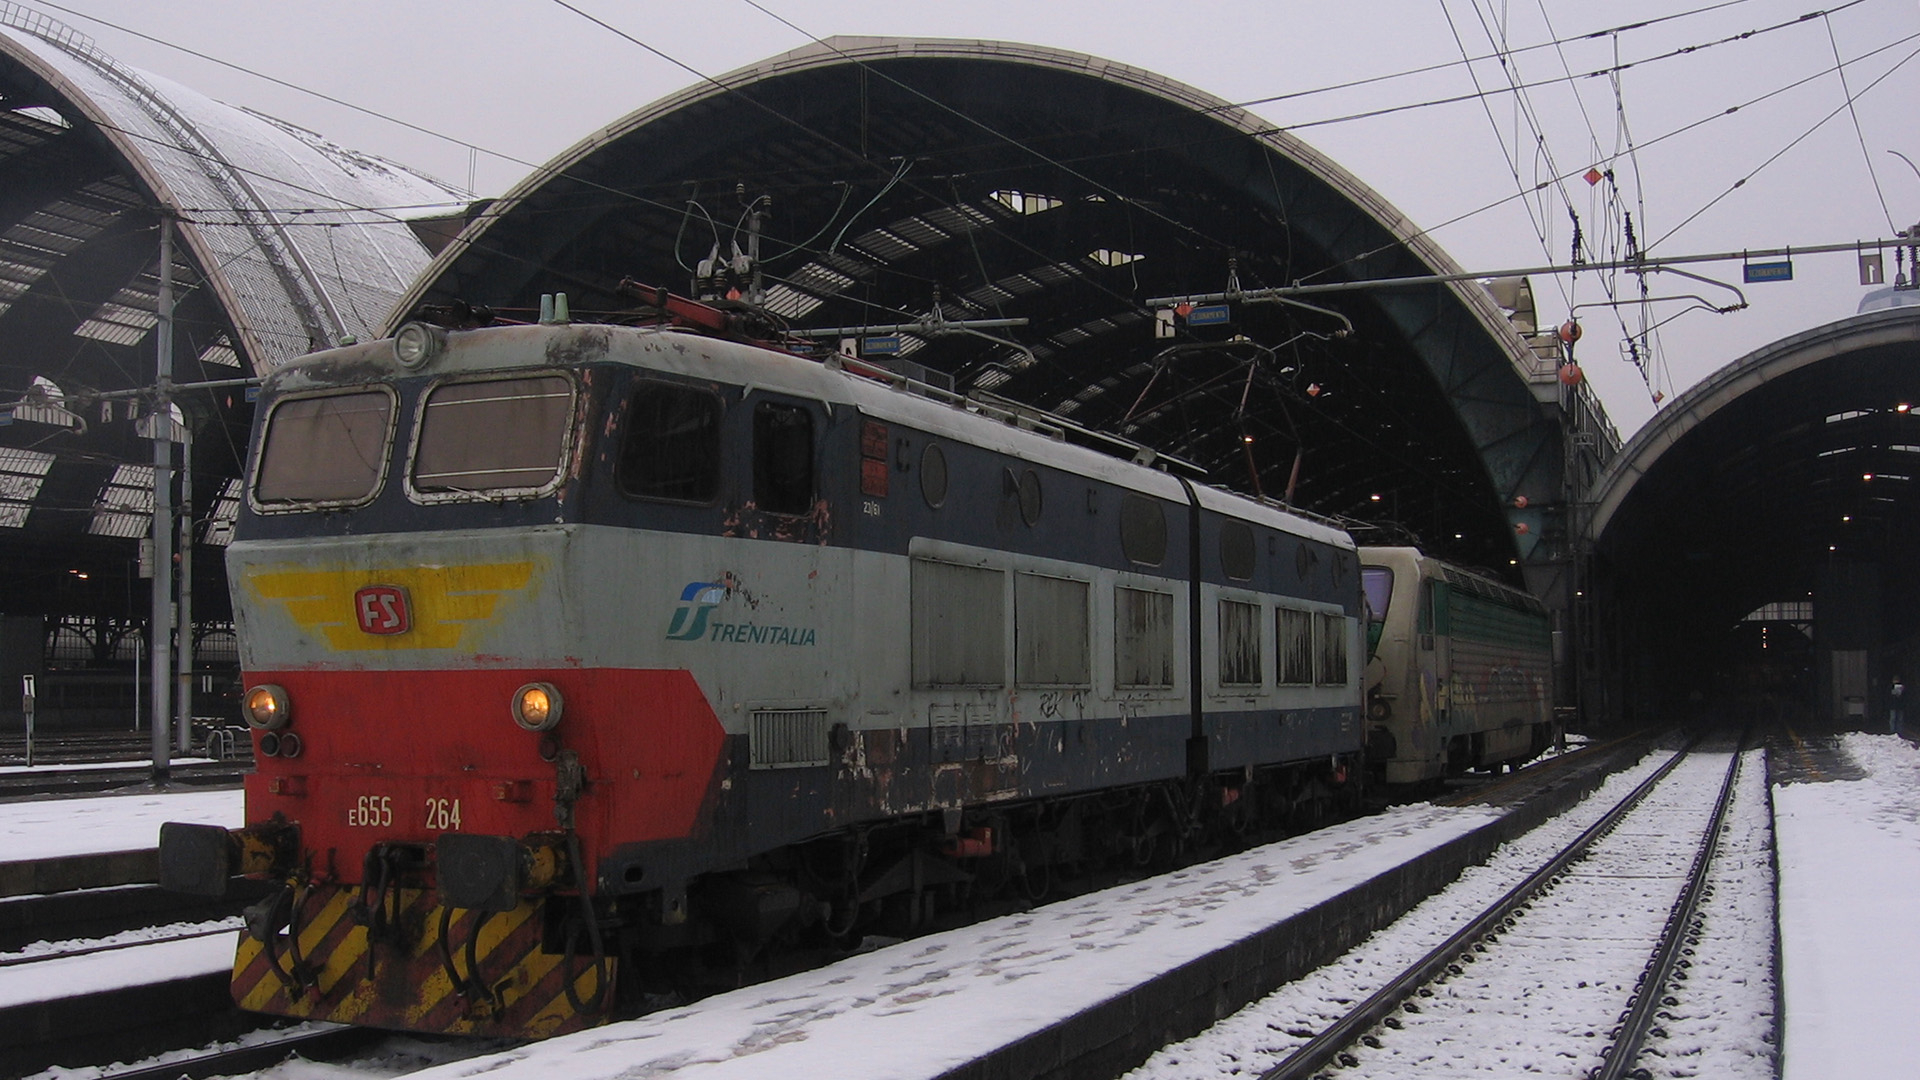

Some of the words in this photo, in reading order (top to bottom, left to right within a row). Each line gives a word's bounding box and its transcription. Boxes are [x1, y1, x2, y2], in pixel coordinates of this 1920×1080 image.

[361, 594, 400, 628] FS
[711, 622, 816, 646] TRENITALIA
[426, 798, 461, 830] 264
